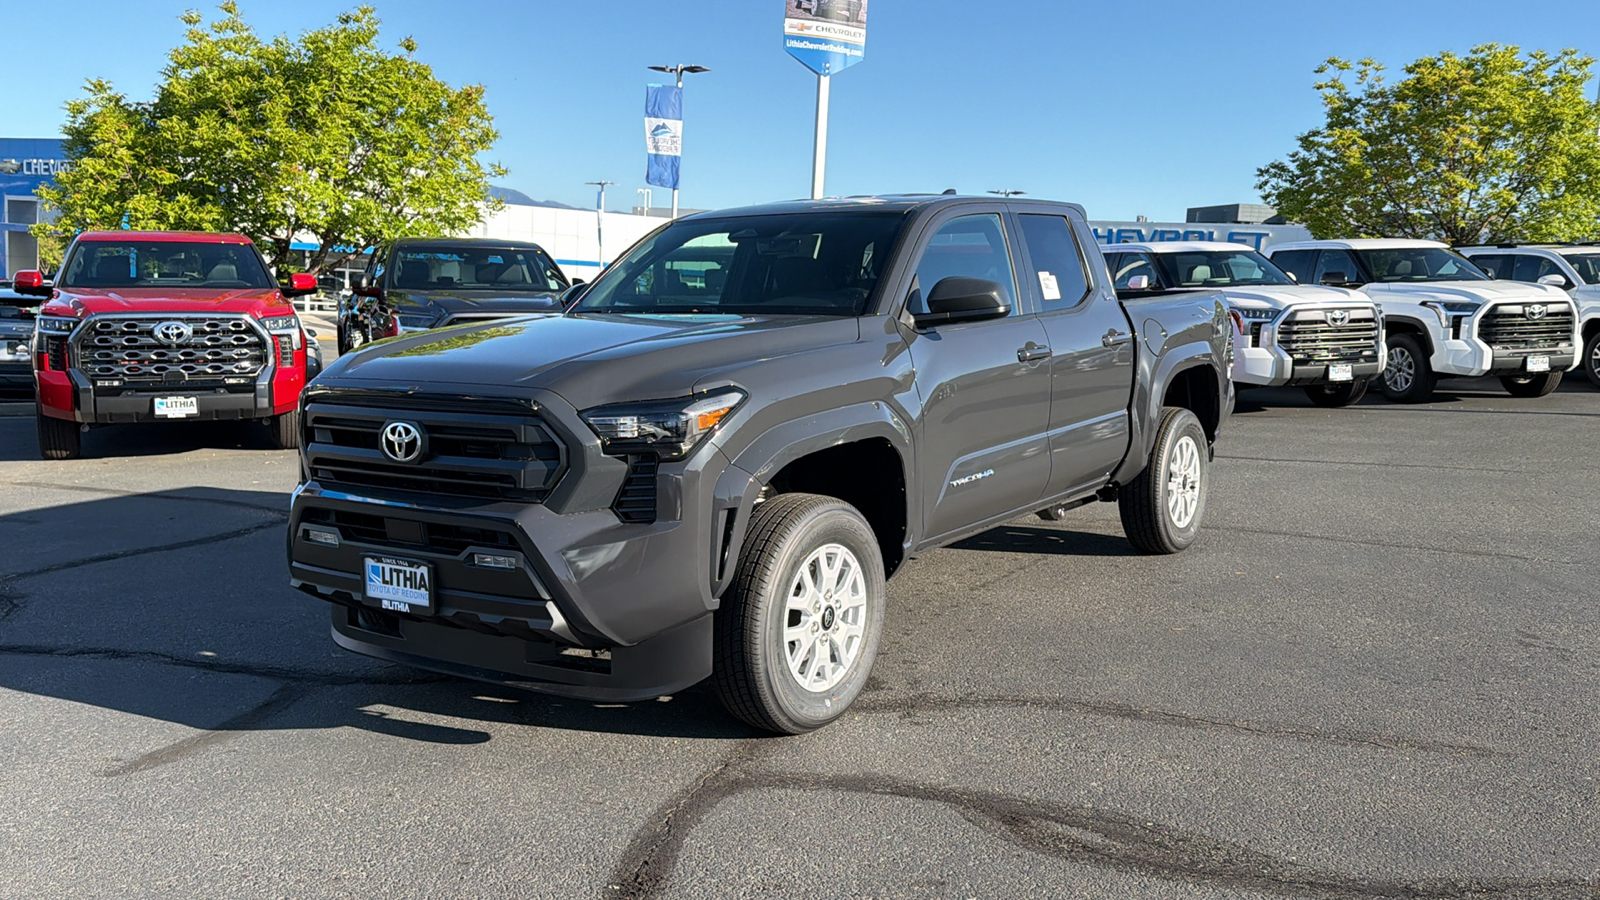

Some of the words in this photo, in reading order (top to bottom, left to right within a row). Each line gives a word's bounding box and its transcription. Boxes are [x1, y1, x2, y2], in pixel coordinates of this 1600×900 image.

[815, 25, 862, 38] CHEVROLET
[23, 158, 70, 175] CHEVR
[165, 400, 195, 409] LITHIA
[949, 468, 995, 488] TACOMA
[381, 566, 429, 592] LITHIA
[368, 583, 391, 595] TOYOTA
[392, 587, 400, 596] OF
[401, 589, 429, 601] REDDING
[388, 600, 410, 613] LITHIA
